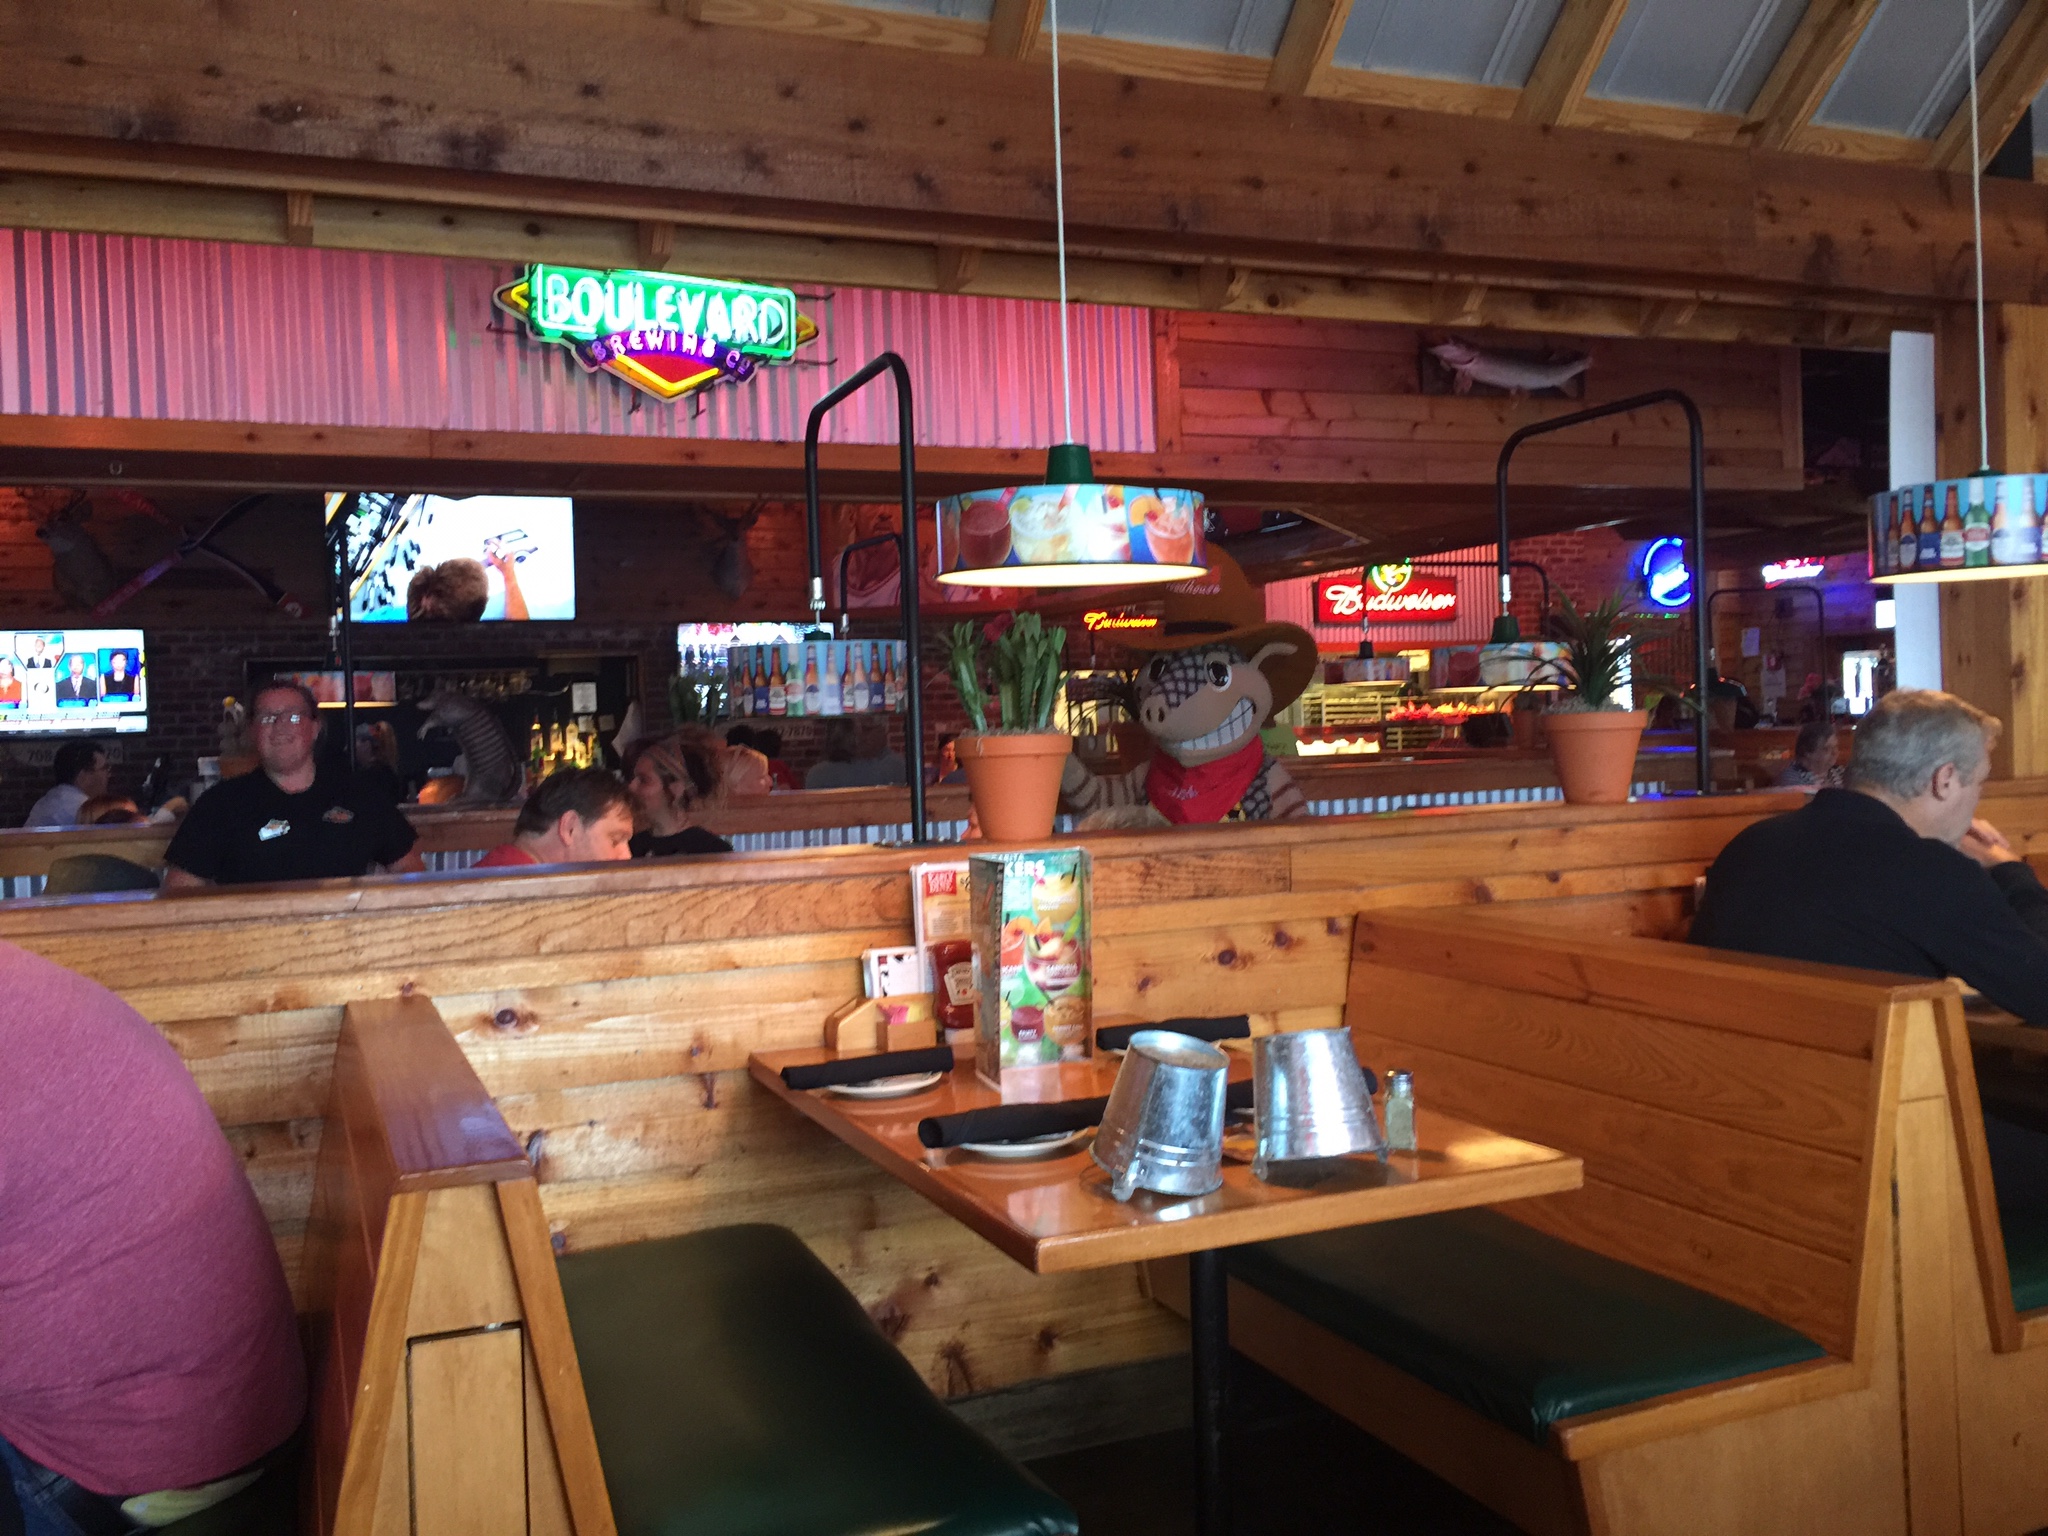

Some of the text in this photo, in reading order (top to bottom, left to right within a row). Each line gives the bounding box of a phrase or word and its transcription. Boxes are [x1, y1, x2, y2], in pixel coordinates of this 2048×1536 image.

[546, 273, 788, 344] BOULEVARD
[591, 329, 717, 361] BREWING
[1004, 859, 1046, 878] KERS
